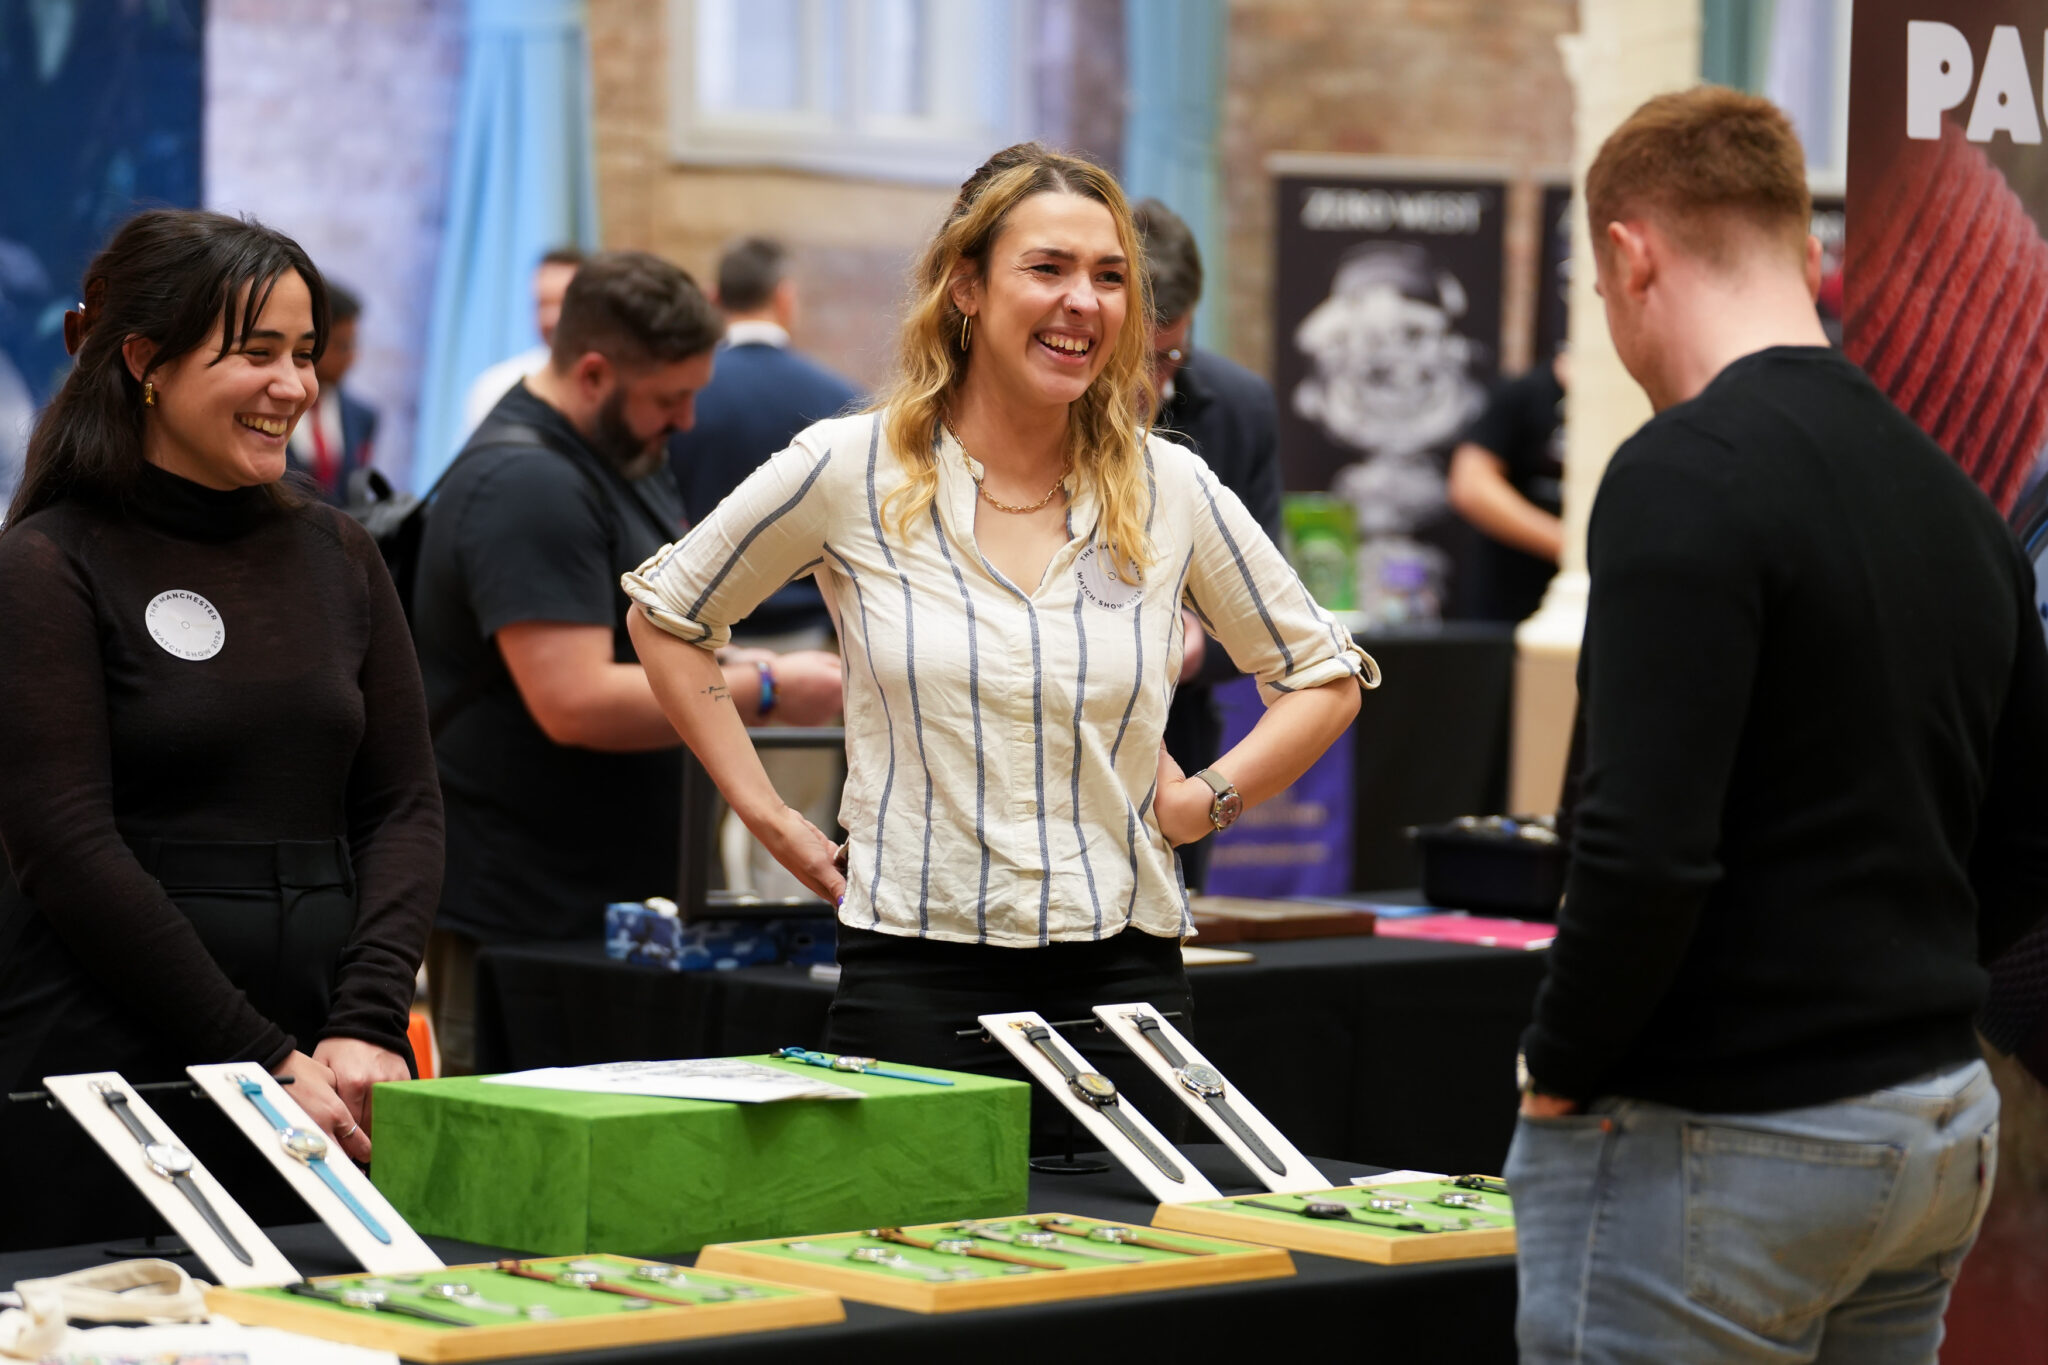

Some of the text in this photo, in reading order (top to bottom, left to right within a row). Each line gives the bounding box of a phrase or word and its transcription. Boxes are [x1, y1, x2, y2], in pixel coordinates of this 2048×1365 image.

[1907, 19, 2048, 145] PA
[1080, 548, 1095, 561] THE
[1077, 571, 1096, 601] WATCH
[1098, 600, 1124, 610] SHOW
[149, 592, 218, 620] THE MANCHESTER
[153, 628, 182, 655] WATCH
[185, 649, 212, 658] SHOW
